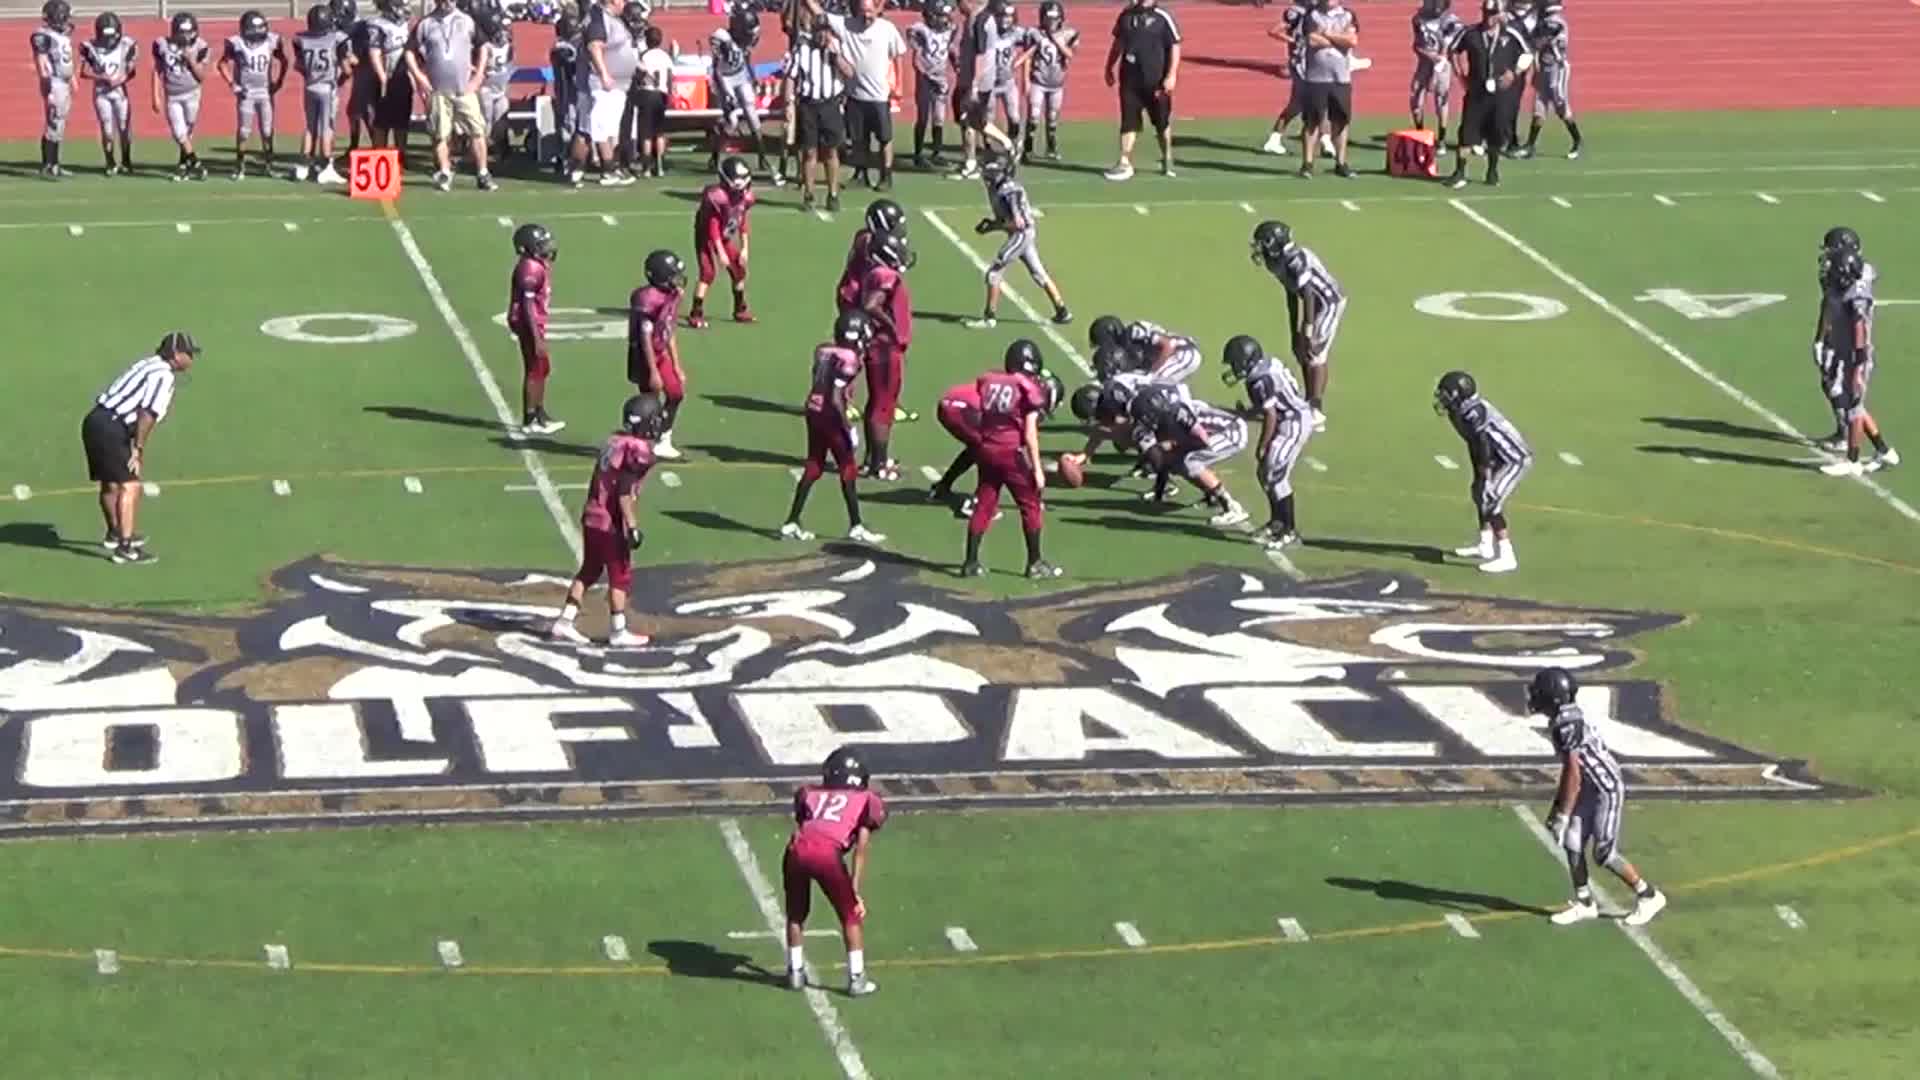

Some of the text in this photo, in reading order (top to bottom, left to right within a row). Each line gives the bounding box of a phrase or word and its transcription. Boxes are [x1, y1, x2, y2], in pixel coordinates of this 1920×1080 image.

[355, 156, 391, 192] 50
[984, 382, 1015, 414] 78
[812, 792, 848, 823] 12
